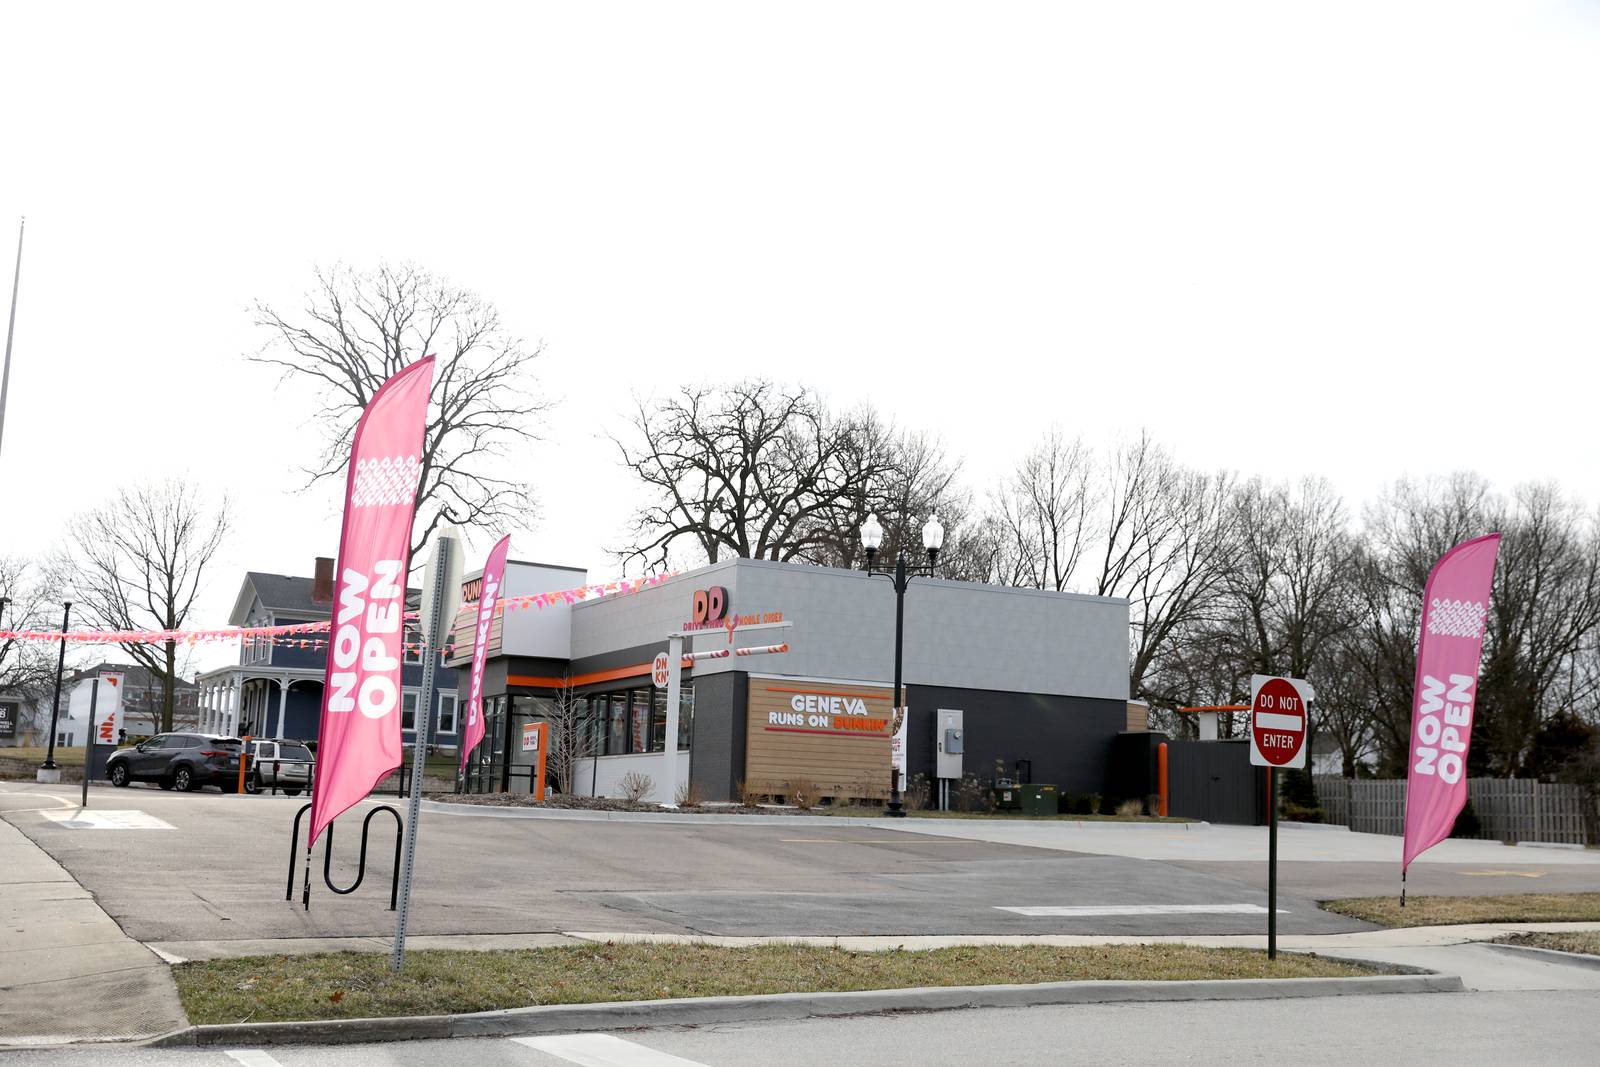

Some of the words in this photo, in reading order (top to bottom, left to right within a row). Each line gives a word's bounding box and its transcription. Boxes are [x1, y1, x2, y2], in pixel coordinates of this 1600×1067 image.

[693, 586, 726, 625] DD
[328, 568, 368, 712] NOW
[358, 560, 402, 719] OPEN
[656, 658, 668, 670] DN
[791, 694, 868, 716] GENEVA
[1260, 694, 1274, 708] DO
[1280, 696, 1298, 710] NOT
[768, 712, 804, 726] RUNS
[808, 714, 829, 728] ON
[1414, 675, 1446, 776] NOW
[1438, 674, 1474, 784] OPEN
[1264, 734, 1294, 748] ENTER
